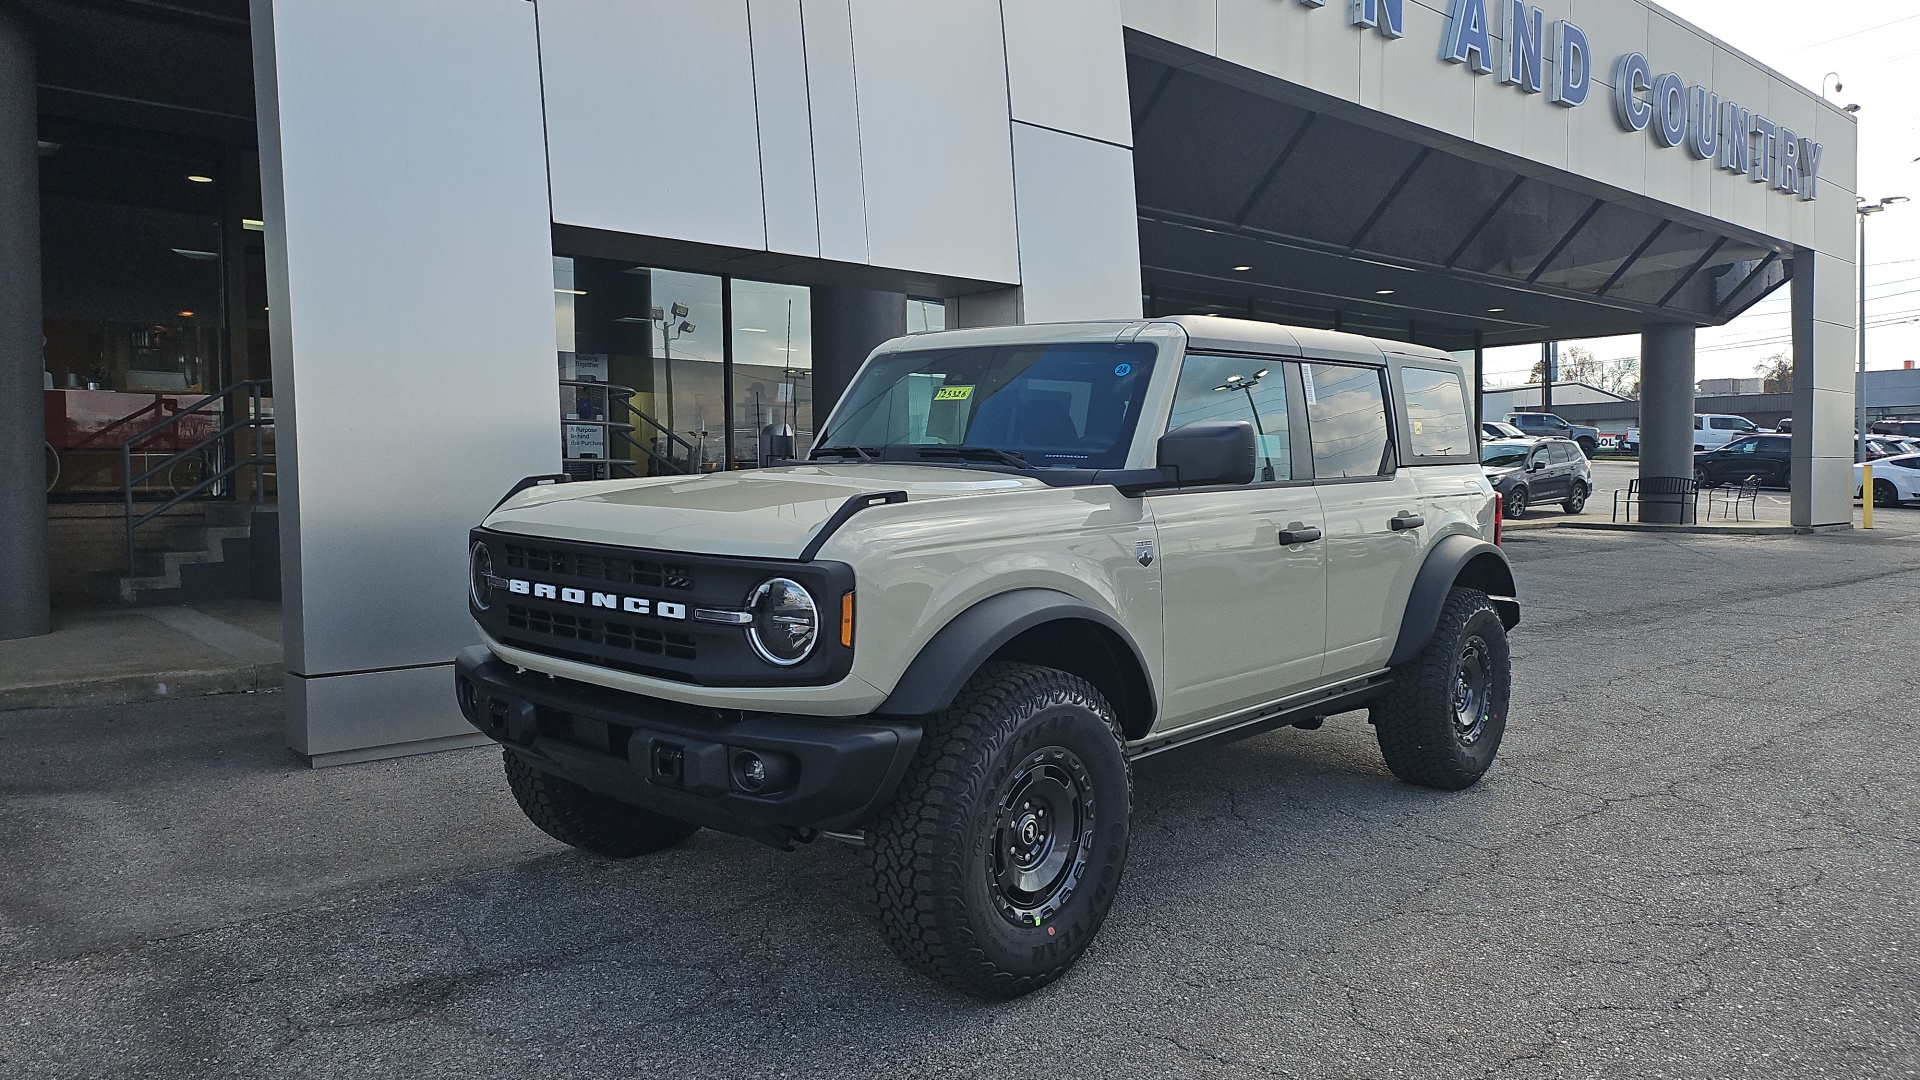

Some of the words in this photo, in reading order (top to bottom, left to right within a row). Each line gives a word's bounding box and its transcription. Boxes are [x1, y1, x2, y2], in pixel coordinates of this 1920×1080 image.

[1444, 0, 1592, 108] AND
[1615, 51, 1824, 201] COUNTRY
[509, 578, 686, 620] BRONCO
